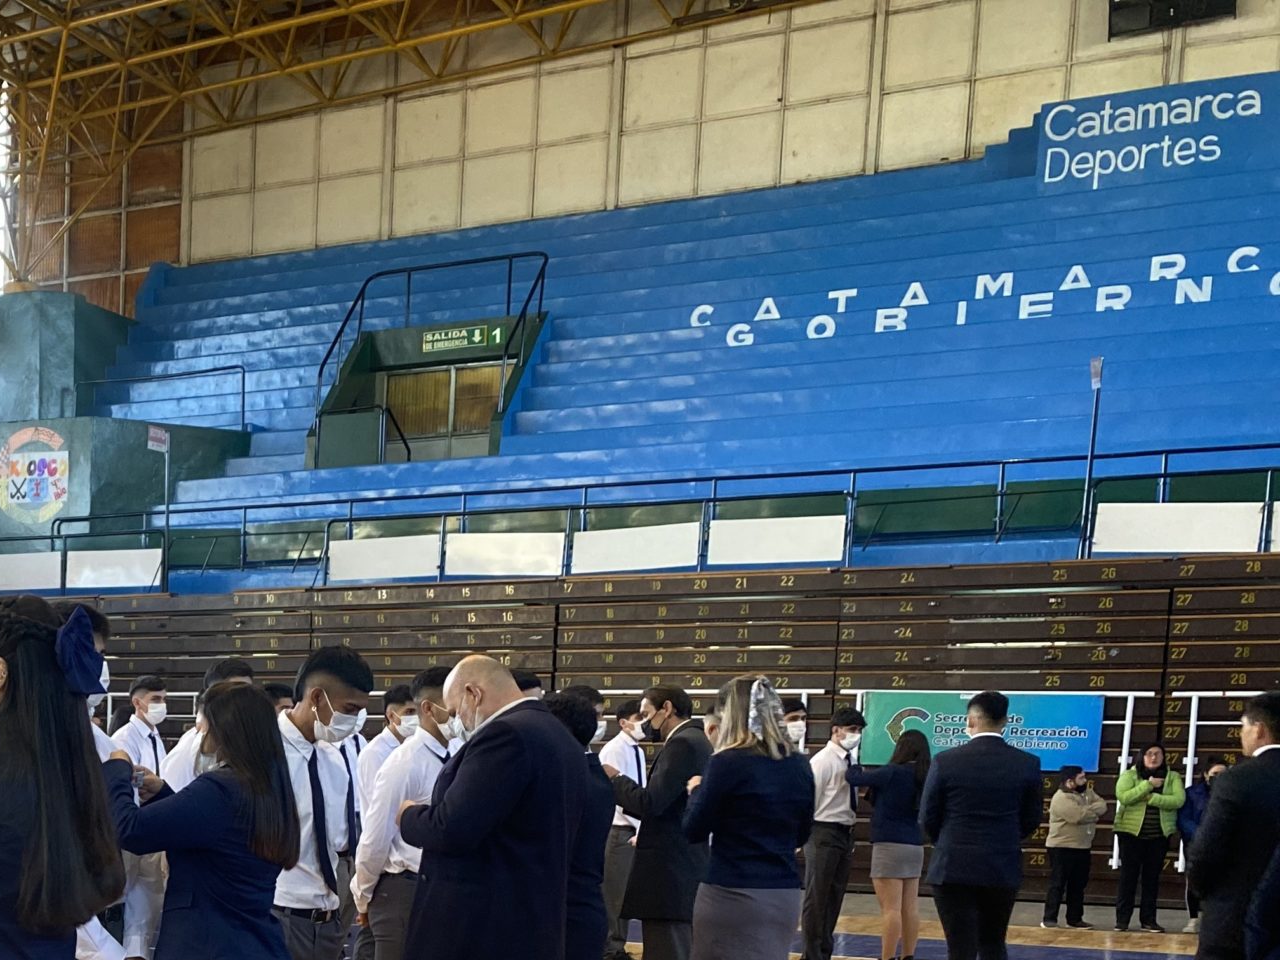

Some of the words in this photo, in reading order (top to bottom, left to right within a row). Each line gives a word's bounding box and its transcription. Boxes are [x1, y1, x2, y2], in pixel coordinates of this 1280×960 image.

[1045, 89, 1262, 142] Catamarca
[1044, 134, 1222, 190] Deportes
[425, 330, 468, 341] SALIDA
[491, 327, 501, 343] 1
[266, 593, 275, 603] 10
[314, 592, 322, 602] 11
[344, 591, 352, 601] 12
[378, 590, 387, 600] 13
[426, 589, 434, 599] 14
[462, 588, 470, 597] 15
[505, 585, 514, 595] 16
[564, 583, 573, 593] 17
[604, 582, 613, 592] 18
[694, 579, 707, 589] 20
[736, 578, 747, 589] 21
[780, 576, 795, 586] 22
[843, 574, 856, 584] 23
[900, 572, 914, 583] 24
[1052, 570, 1067, 580] 25
[1101, 568, 1116, 579] 26
[1179, 564, 1196, 577] 27
[1246, 561, 1261, 573] 28
[267, 616, 275, 626] 10
[314, 616, 322, 626] 11
[467, 612, 476, 622] 15
[502, 611, 513, 622] 16
[565, 609, 576, 619] 17
[658, 606, 667, 616] 19
[698, 606, 709, 615] 20
[740, 604, 749, 614] 21
[781, 603, 795, 614] 22
[843, 602, 856, 613] 23
[900, 601, 913, 612] 24
[1098, 597, 1113, 608] 26
[1176, 594, 1192, 606] 27
[1240, 592, 1255, 604] 28
[270, 638, 278, 648] 10
[563, 632, 574, 642] 17
[695, 630, 706, 639] 20
[737, 628, 748, 639] 21
[779, 628, 793, 638] 22
[842, 629, 855, 639] 23
[899, 627, 912, 637] 24
[1050, 624, 1065, 635] 25
[1096, 622, 1111, 634] 26
[1173, 622, 1189, 634] 27
[1234, 620, 1249, 631] 28
[267, 660, 275, 669] 10
[500, 656, 510, 666] 16
[562, 655, 573, 665] 17
[654, 655, 662, 664] 19
[694, 654, 706, 664] 20
[736, 652, 747, 663] 21
[779, 654, 791, 665] 22
[840, 652, 854, 663] 23
[894, 651, 908, 662] 24
[1171, 647, 1187, 659] 27
[1234, 646, 1250, 658] 28
[561, 678, 571, 688] 17
[691, 676, 702, 686] 20
[838, 677, 851, 687] 23
[891, 676, 906, 687] 24
[1045, 675, 1061, 686] 25
[1090, 675, 1105, 687] 26
[1169, 675, 1186, 687] 27
[1230, 673, 1246, 684] 28
[1166, 701, 1182, 712] 27
[1230, 701, 1244, 711] 28
[1007, 715, 1023, 724] de
[934, 725, 968, 737] Depo
[1010, 726, 1088, 738] Recreación
[1165, 727, 1181, 738] 27
[1007, 738, 1068, 750] Gobierno
[1224, 753, 1236, 764] 28
[1032, 830, 1047, 840] 25
